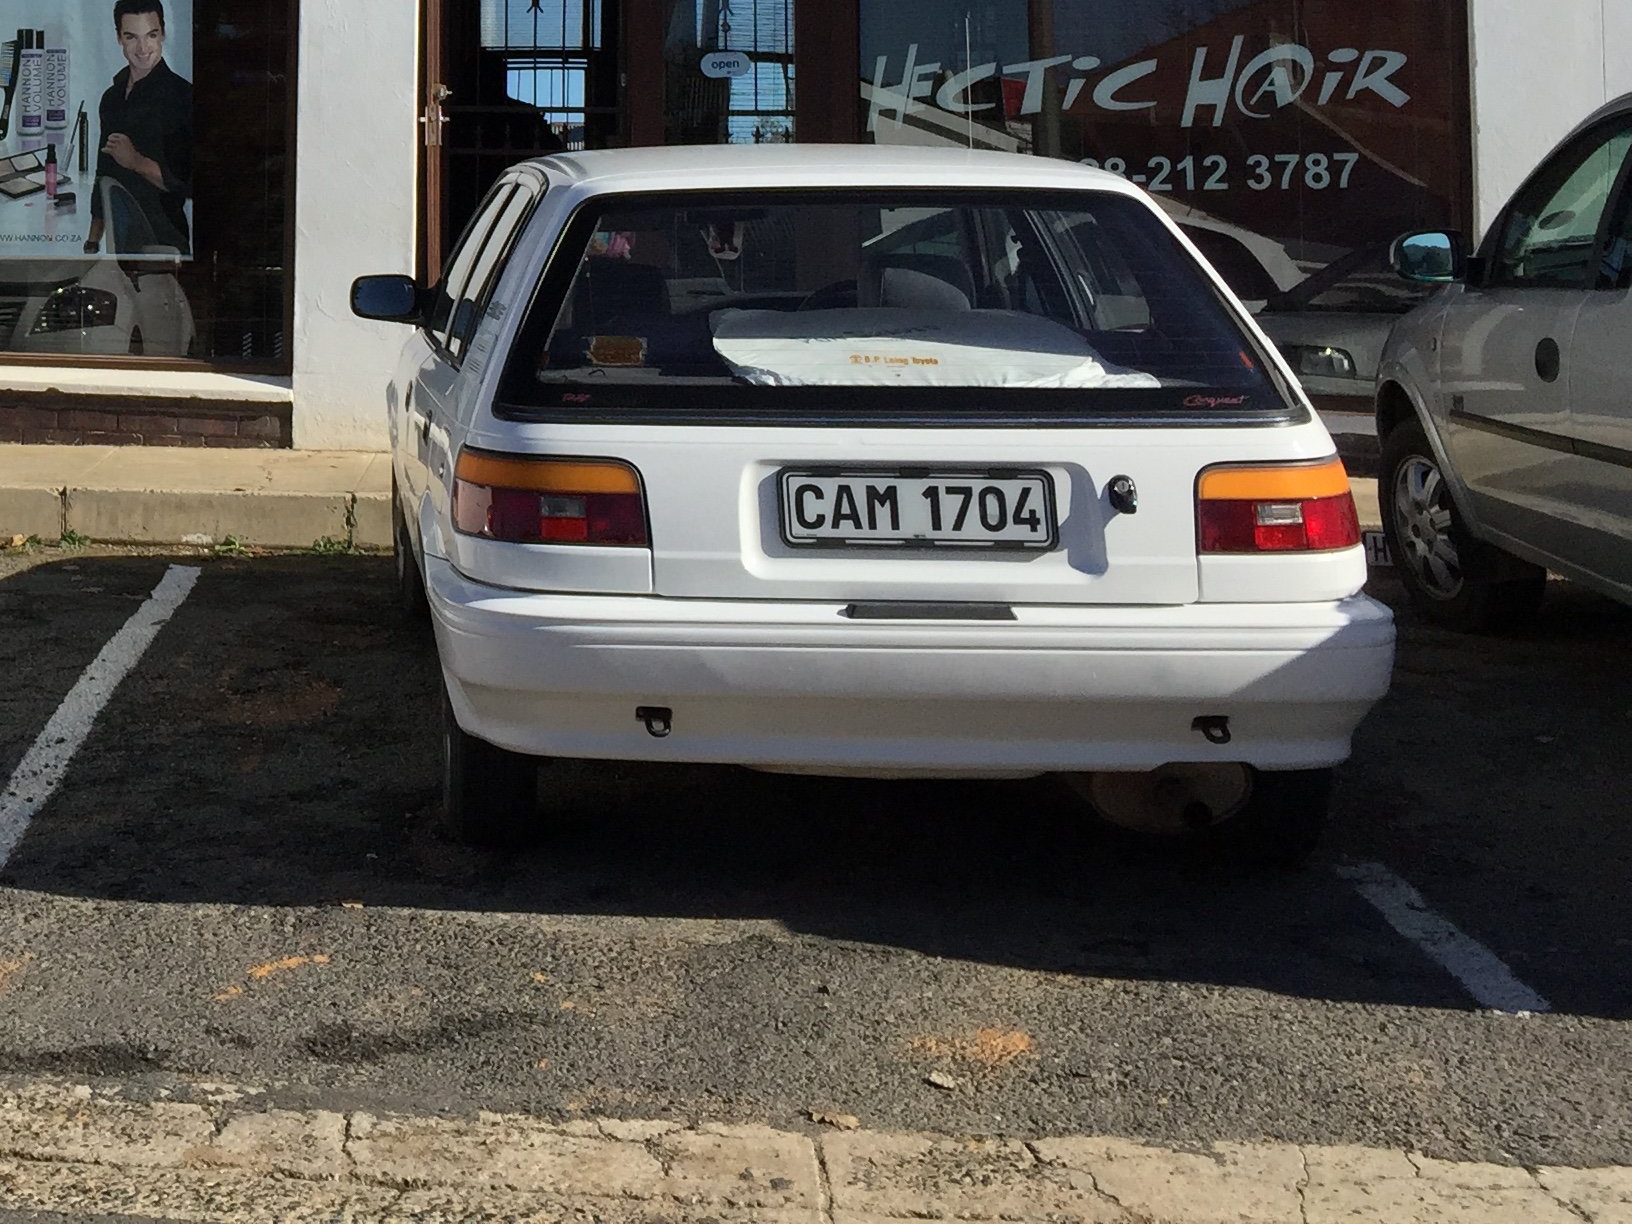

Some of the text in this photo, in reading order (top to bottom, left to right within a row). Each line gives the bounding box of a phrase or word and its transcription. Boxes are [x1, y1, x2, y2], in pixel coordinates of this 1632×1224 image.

[22, 59, 32, 113] HANNON
[33, 58, 43, 113] VOLUME
[47, 54, 56, 107] HANNON
[57, 54, 67, 107] VOLUME
[711, 60, 740, 71] open
[1246, 152, 1359, 191] 3787
[794, 483, 1041, 533] CAM 1704
